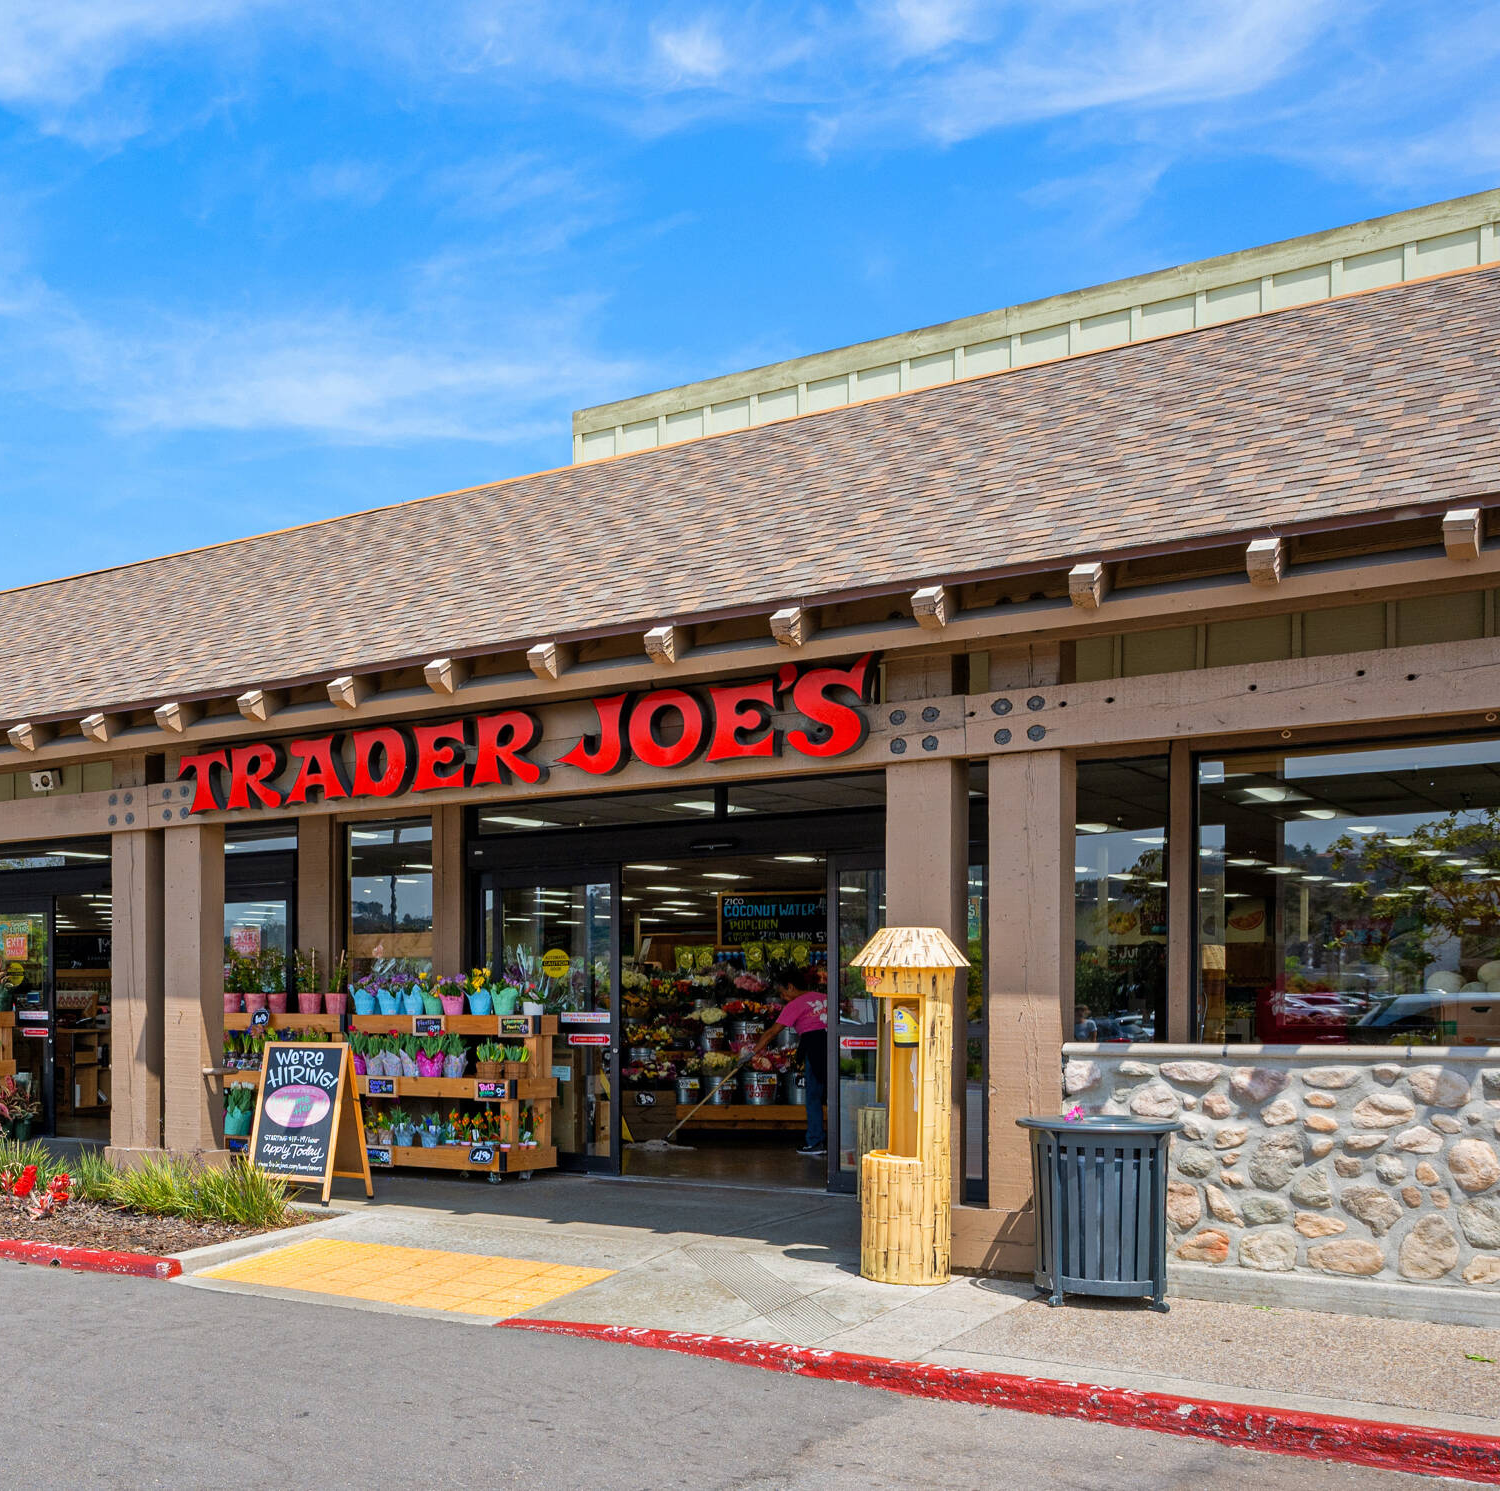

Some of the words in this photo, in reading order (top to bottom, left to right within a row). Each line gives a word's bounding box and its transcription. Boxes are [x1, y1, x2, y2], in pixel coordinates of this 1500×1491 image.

[178, 710, 548, 816] TRADER
[553, 651, 876, 776] JOE'S
[724, 897, 744, 906] ZICO
[723, 904, 778, 918] COCONUT
[778, 903, 816, 916] WATER
[729, 919, 779, 931] POPCORN
[6, 937, 25, 948] EXIT
[234, 931, 257, 944] EXIT
[267, 1065, 339, 1089] HIRING!
[290, 1143, 325, 1163] Today
[603, 1325, 650, 1336] NO
[667, 1331, 834, 1357] PARKING
[1025, 1376, 1152, 1396] LANE
